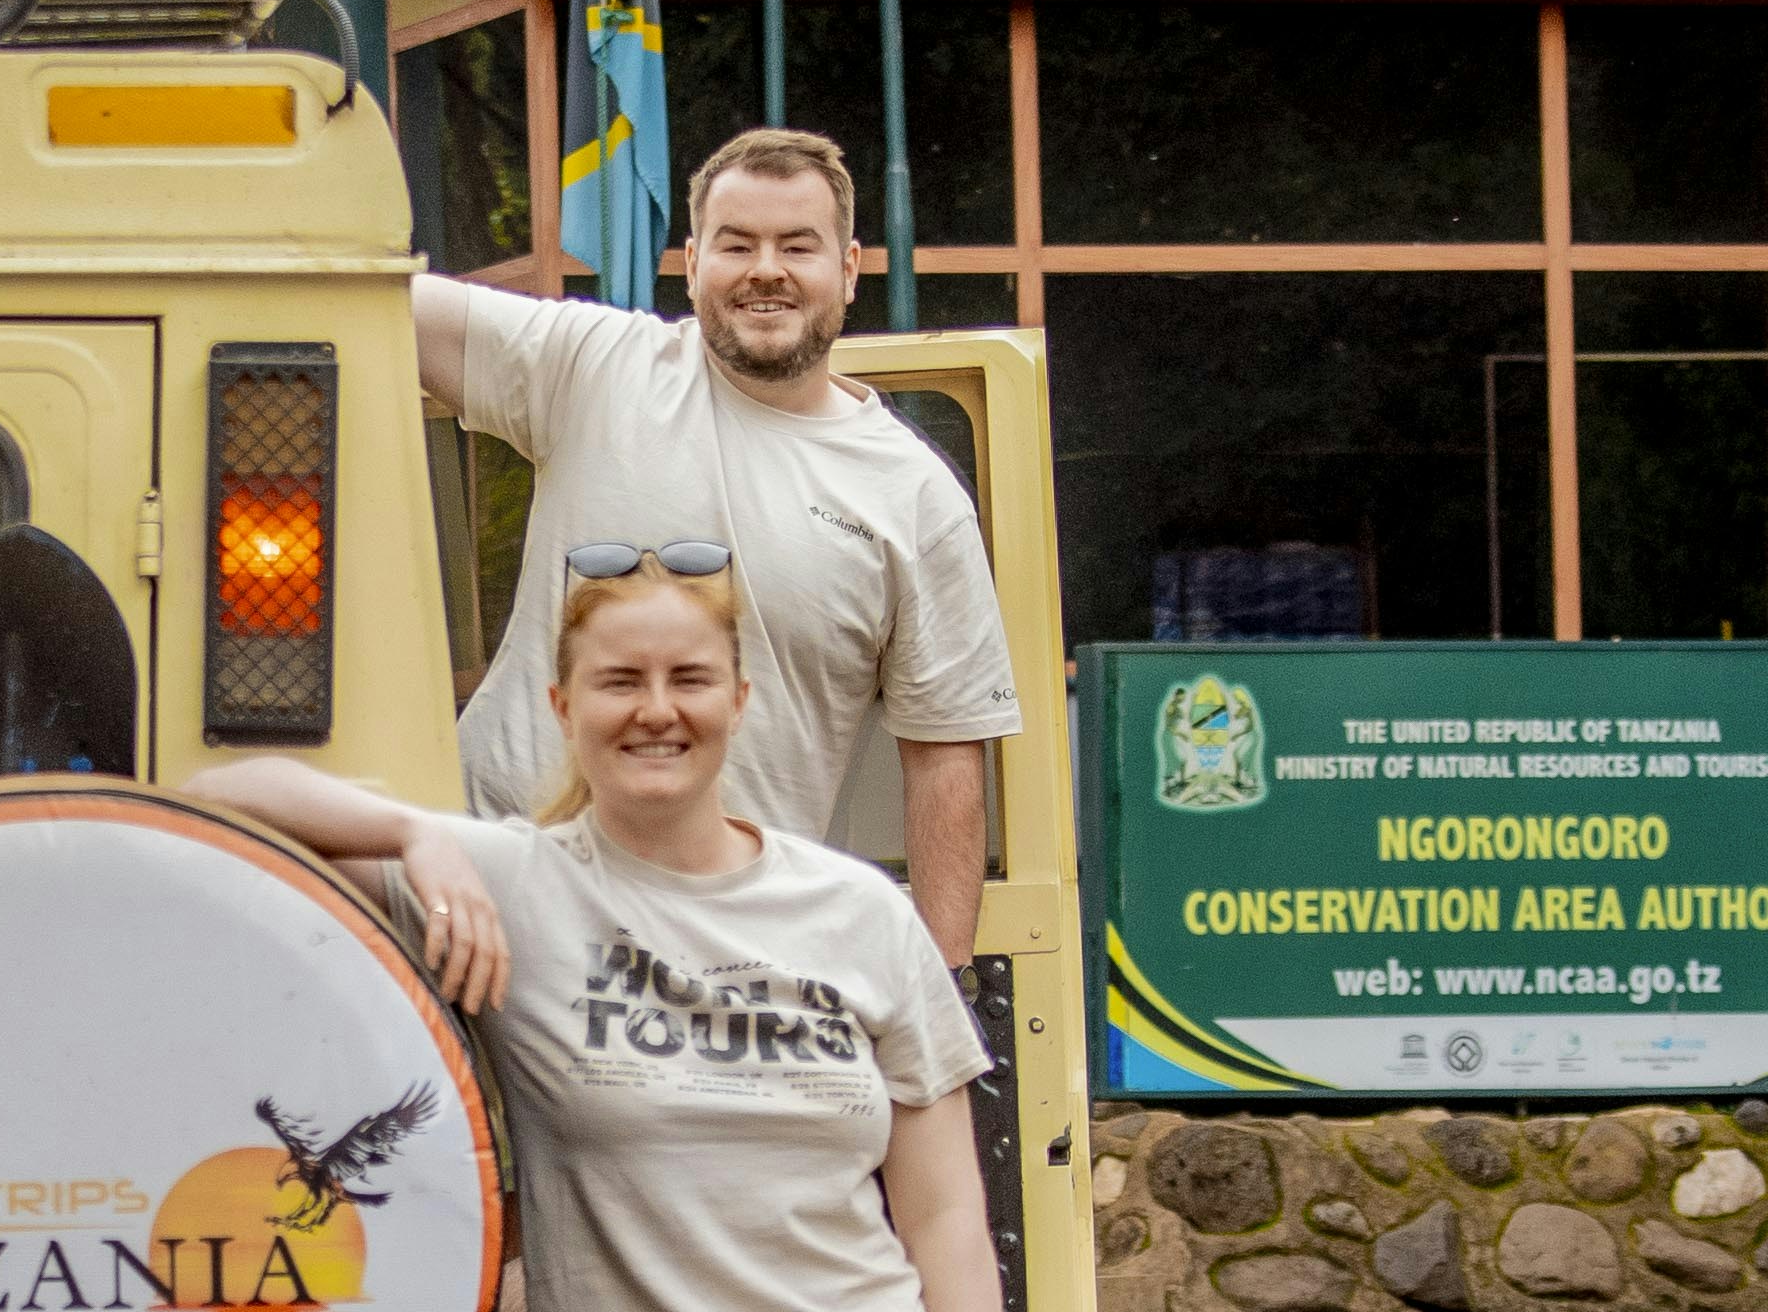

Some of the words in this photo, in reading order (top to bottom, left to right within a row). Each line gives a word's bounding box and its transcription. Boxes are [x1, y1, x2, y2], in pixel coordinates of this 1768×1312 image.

[820, 510, 875, 543] Columbia
[1342, 719, 1388, 744] THE
[1390, 719, 1472, 744] UNITED
[1474, 719, 1578, 743] REPUBLIC
[1581, 718, 1613, 743] OF
[1615, 718, 1722, 743] TANZANIA
[1274, 755, 1378, 780] MINISTRY
[1383, 755, 1415, 780] OF
[1417, 754, 1515, 779] NATURAL
[1518, 754, 1641, 779] RESOURCES
[1644, 754, 1691, 778] AND
[1377, 815, 1671, 862] NGORONGORO
[1183, 887, 1500, 935] CONSERVATION
[1512, 886, 1626, 931] AREA
[1637, 886, 1768, 931] AUTHO
[1333, 959, 1424, 997] web:
[1434, 958, 1723, 1005] www.ncaa.go.tz
[584, 997, 859, 1064] TOURS
